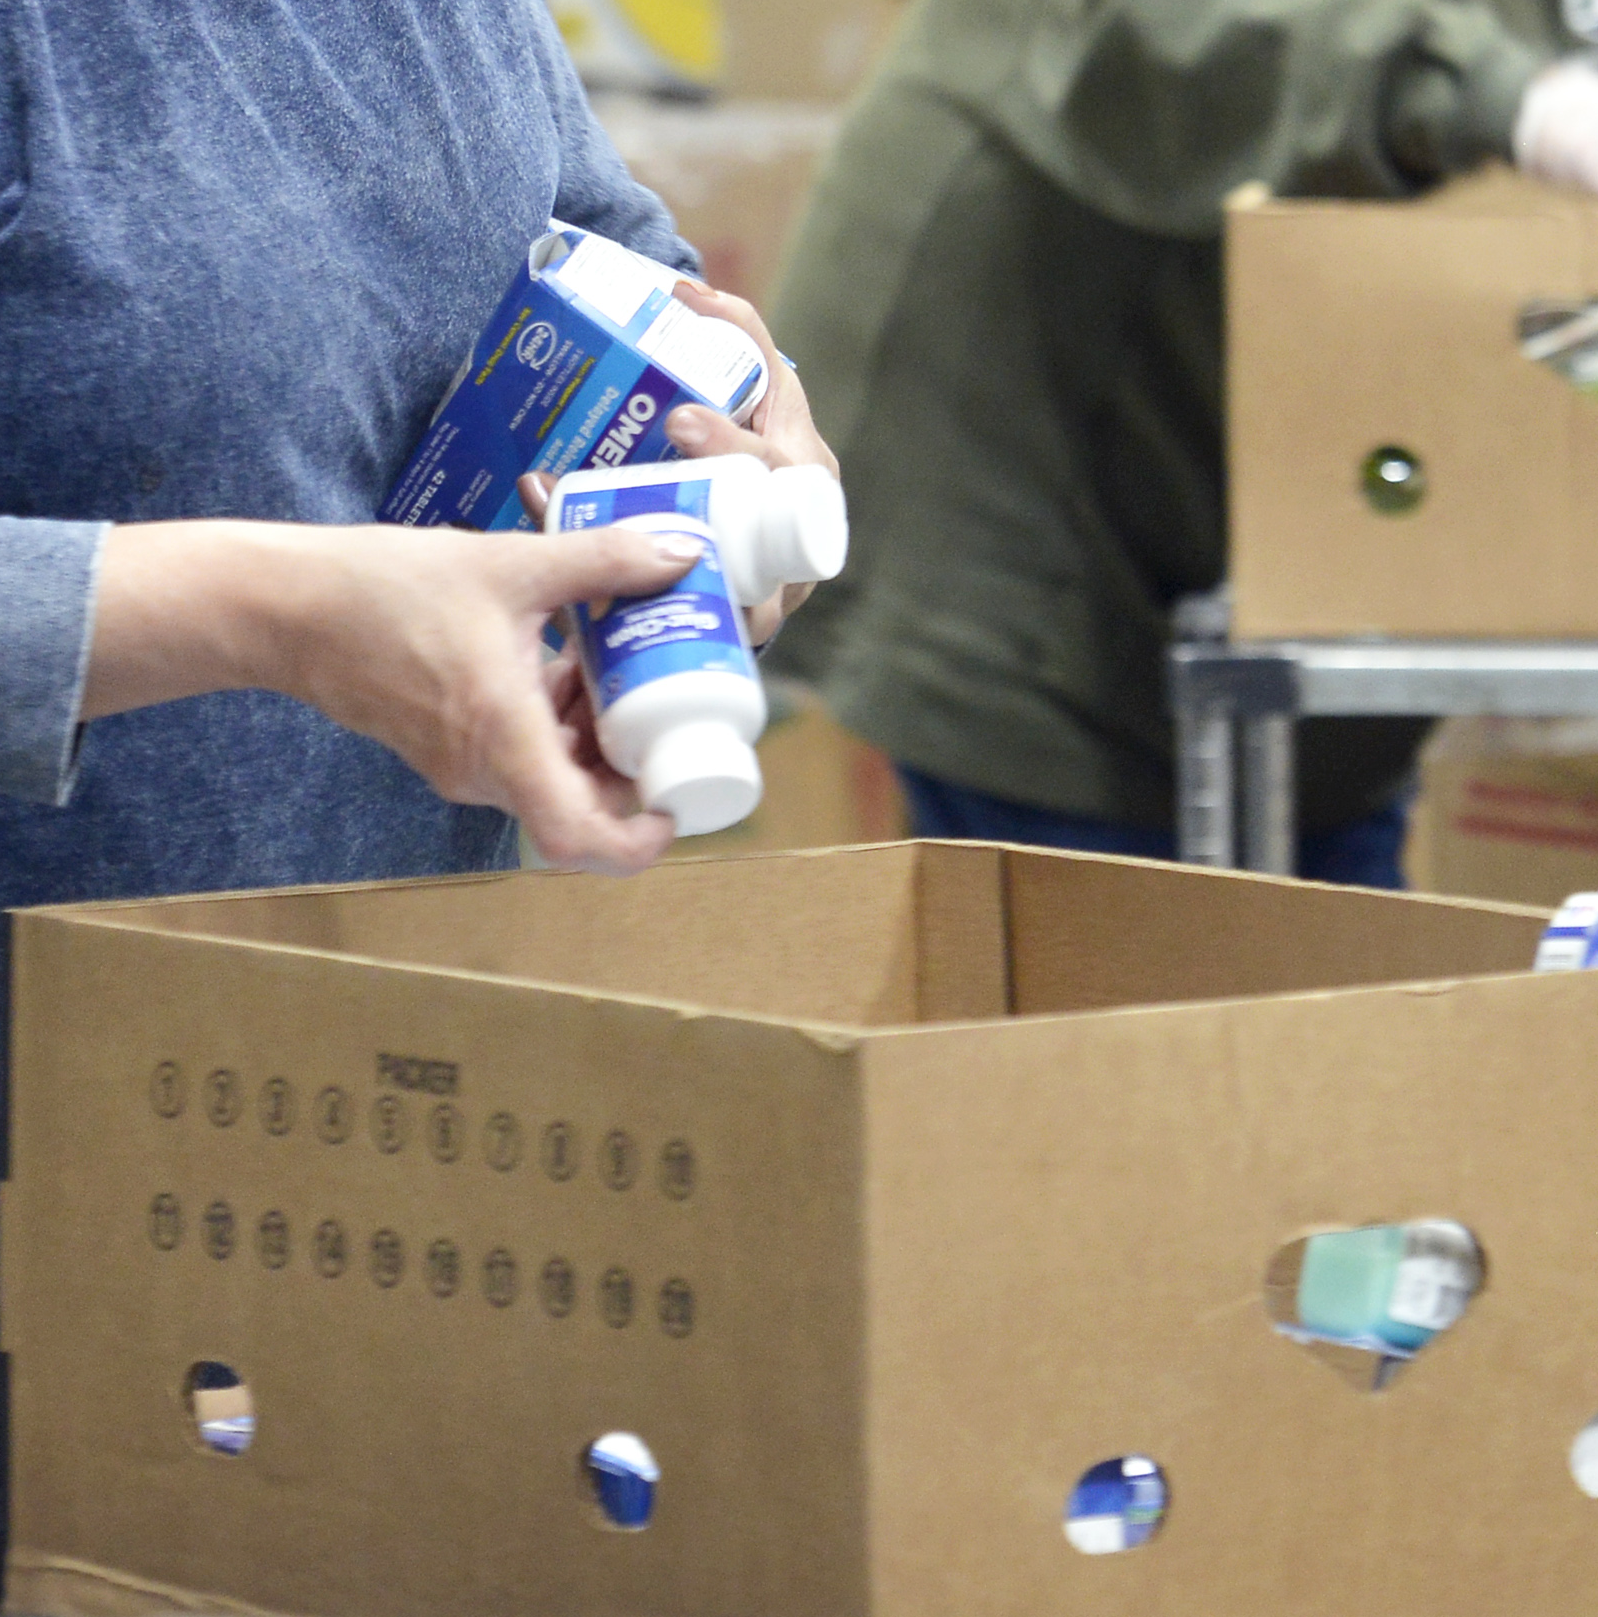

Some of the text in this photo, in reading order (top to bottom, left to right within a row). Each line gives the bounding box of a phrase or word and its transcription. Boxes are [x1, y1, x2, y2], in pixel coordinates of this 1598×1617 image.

[520, 324, 551, 362] 24HR
[543, 338, 573, 377] SWALLOW
[554, 352, 580, 386] BOTTLES
[522, 392, 537, 409] NOT
[533, 380, 544, 393] DO
[539, 383, 559, 408] INSIDE
[507, 407, 527, 431] CHEW
[550, 383, 620, 479] Delayed Releas
[431, 468, 447, 486] 42
[402, 483, 437, 529] TABLETS
